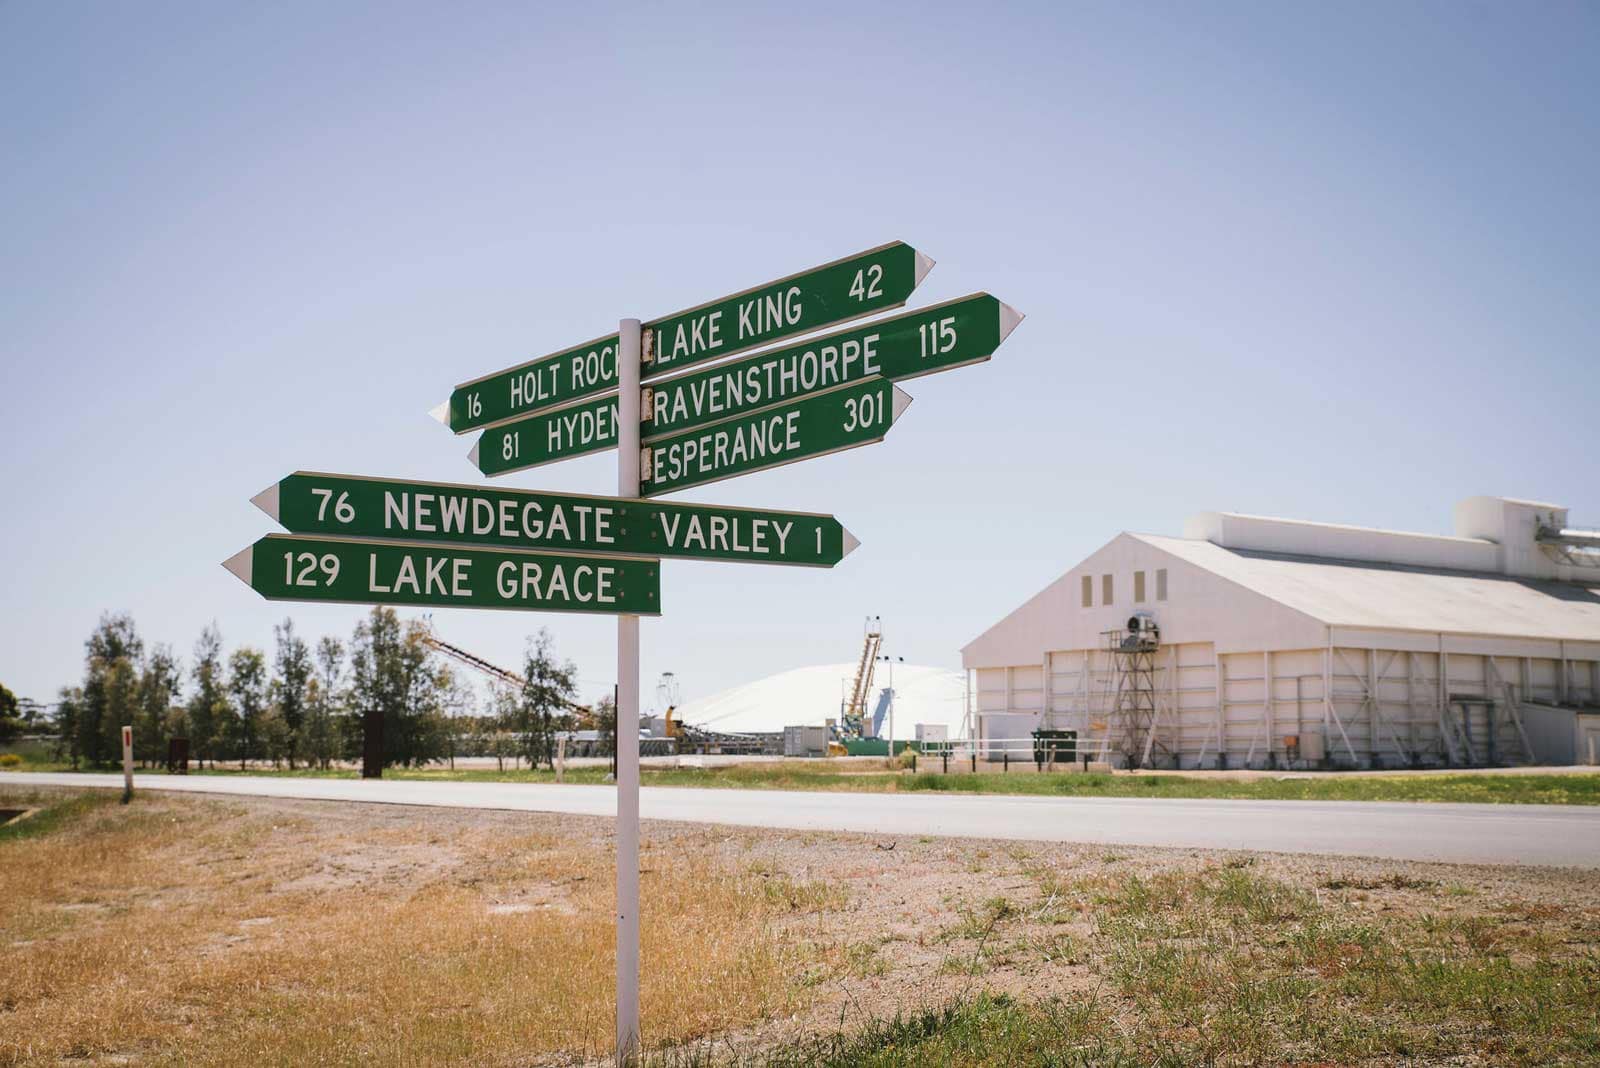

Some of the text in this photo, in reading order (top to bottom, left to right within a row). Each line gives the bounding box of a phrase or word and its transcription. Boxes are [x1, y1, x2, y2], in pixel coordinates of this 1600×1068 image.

[655, 265, 882, 364] LAKE KING 42
[467, 393, 482, 419] 16
[510, 363, 561, 409] HOLT
[654, 317, 957, 427] RAVENSTHORPE 115
[502, 432, 519, 461] 81
[654, 391, 883, 484] ESPERANCE 301
[311, 489, 614, 544] 76 NEWDEGATE
[659, 513, 822, 554] VARLEY 1
[284, 552, 616, 603] 129 LAKE GRACE
